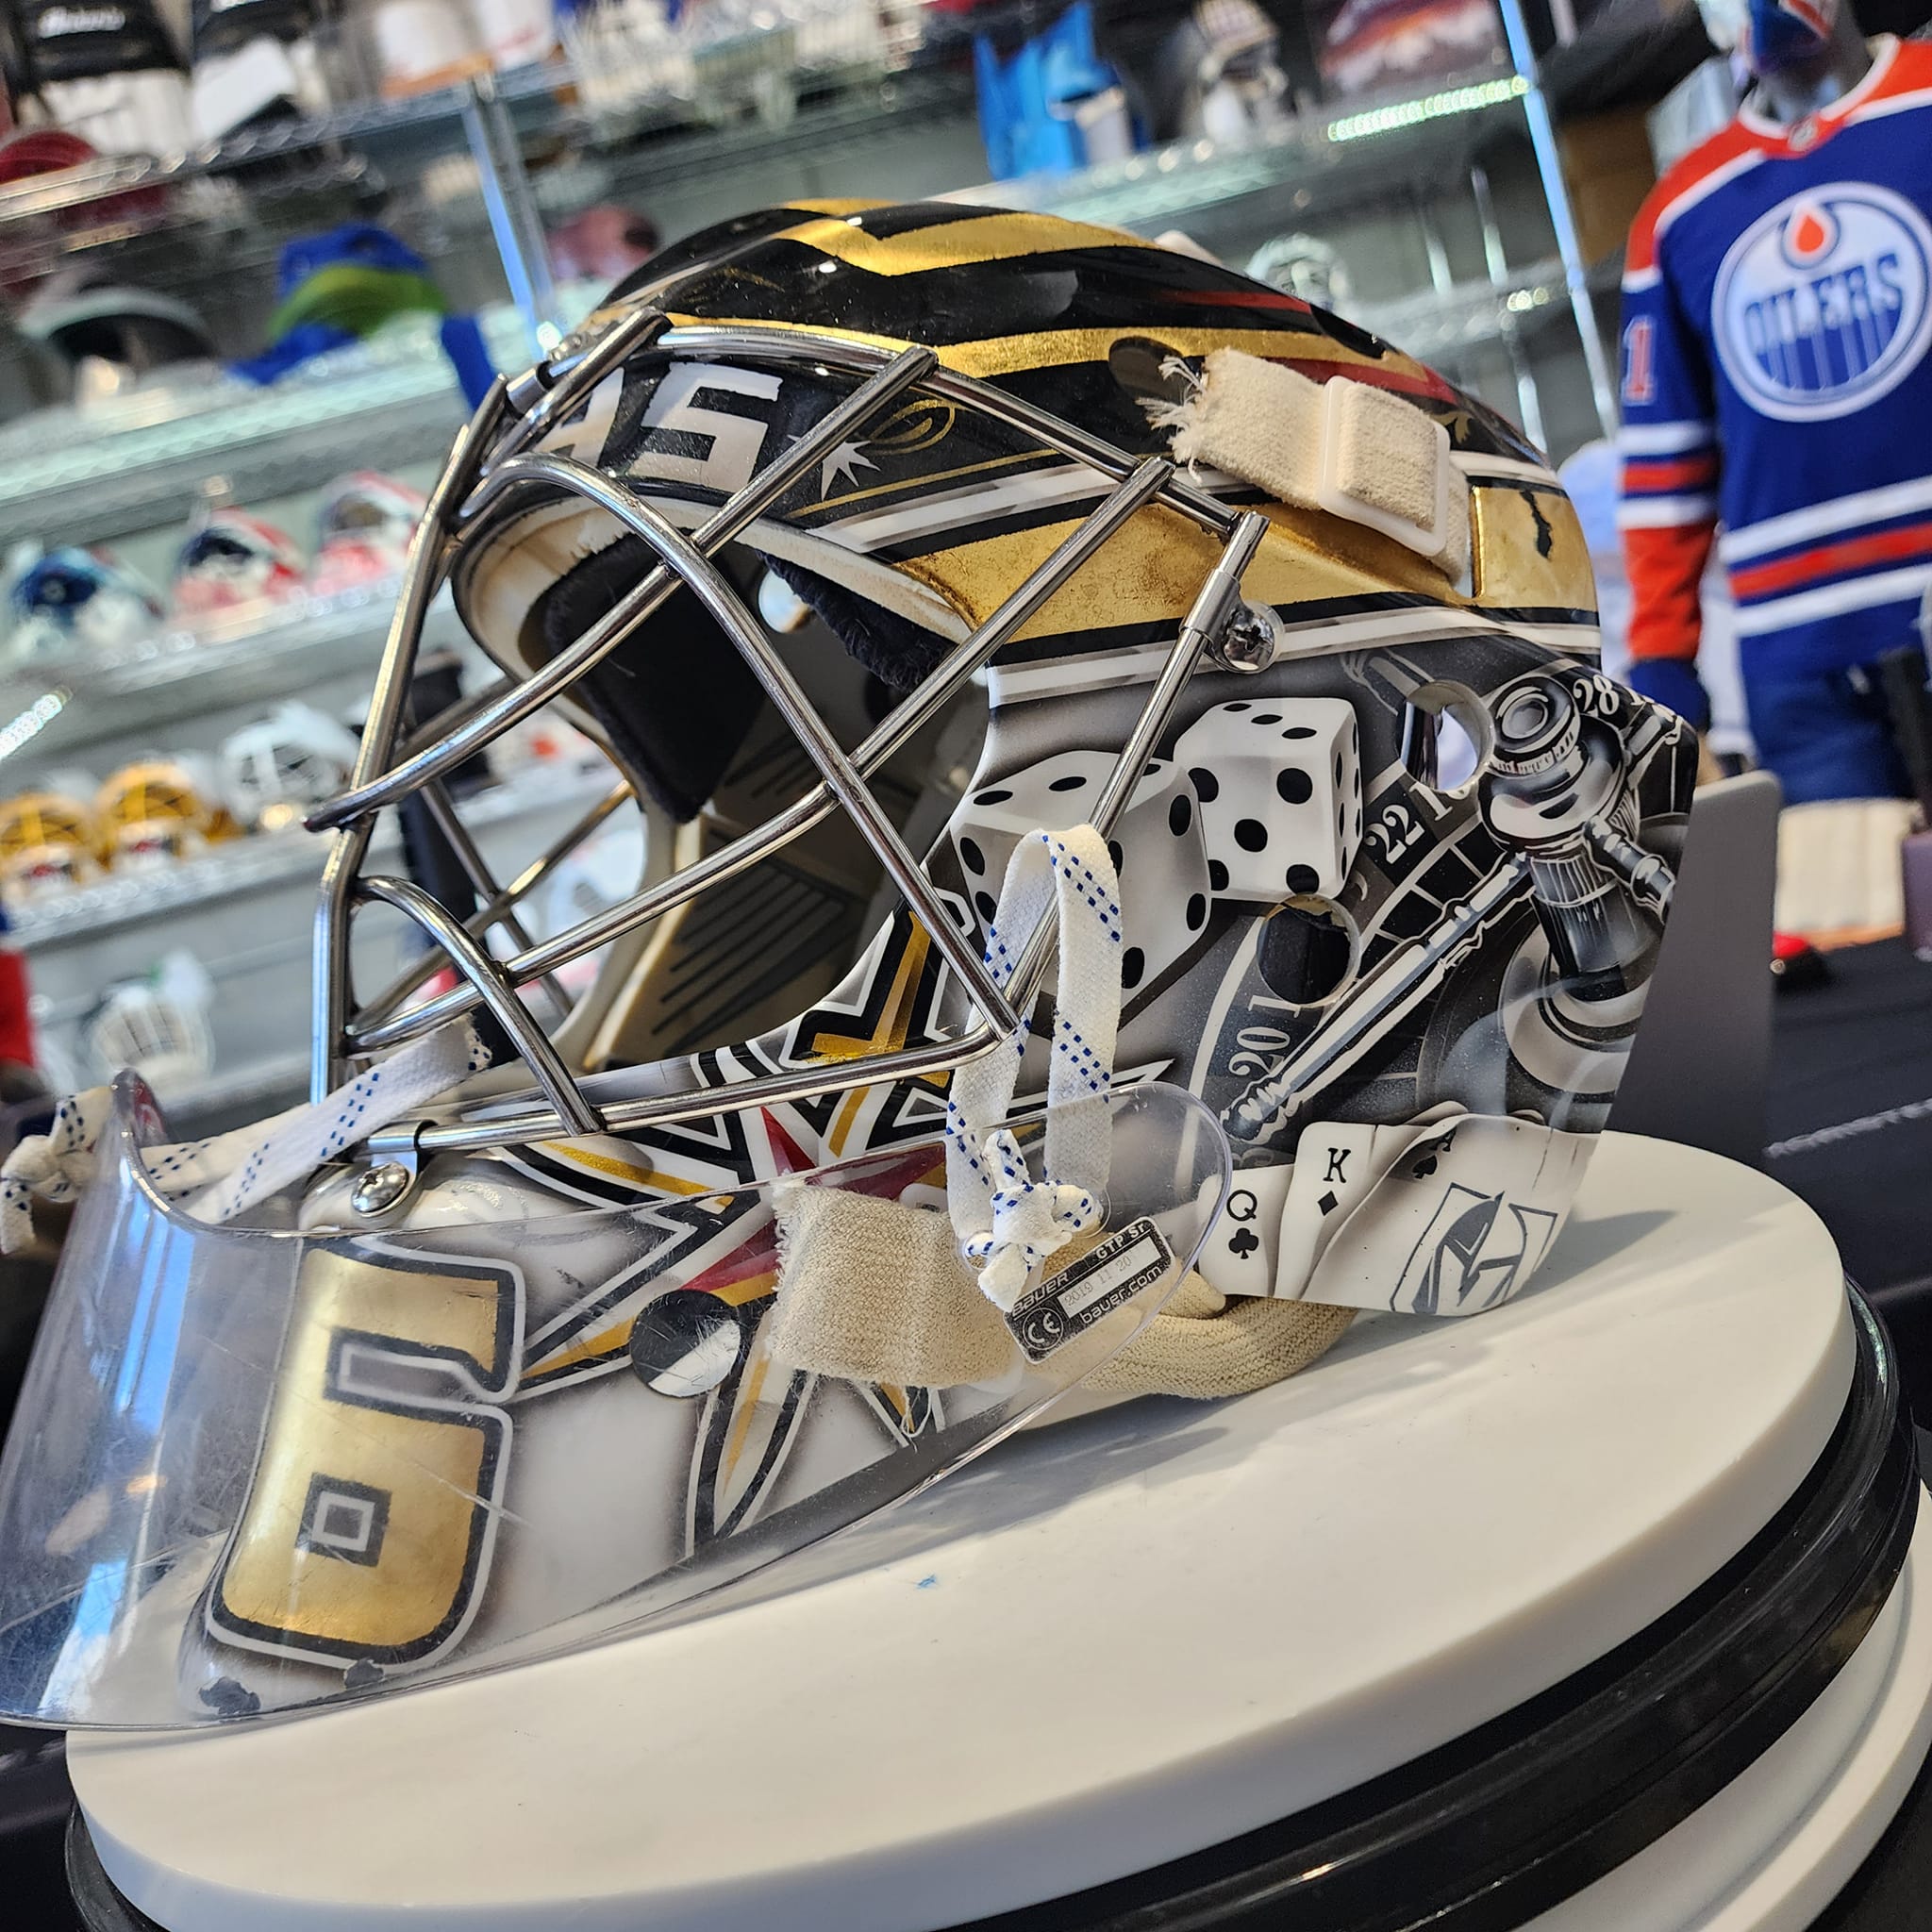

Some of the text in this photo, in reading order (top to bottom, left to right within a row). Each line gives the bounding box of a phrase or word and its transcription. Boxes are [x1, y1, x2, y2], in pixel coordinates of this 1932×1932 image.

[1744, 252, 1903, 357] OILERS
[1323, 1147, 1352, 1183] K
[1226, 1189, 1257, 1222] Q
[1095, 1223, 1147, 1259] GTP Sr
[1064, 1282, 1093, 1307] 2019
[1098, 1269, 1113, 1284] 11
[1079, 1265, 1162, 1324] bauer.com
